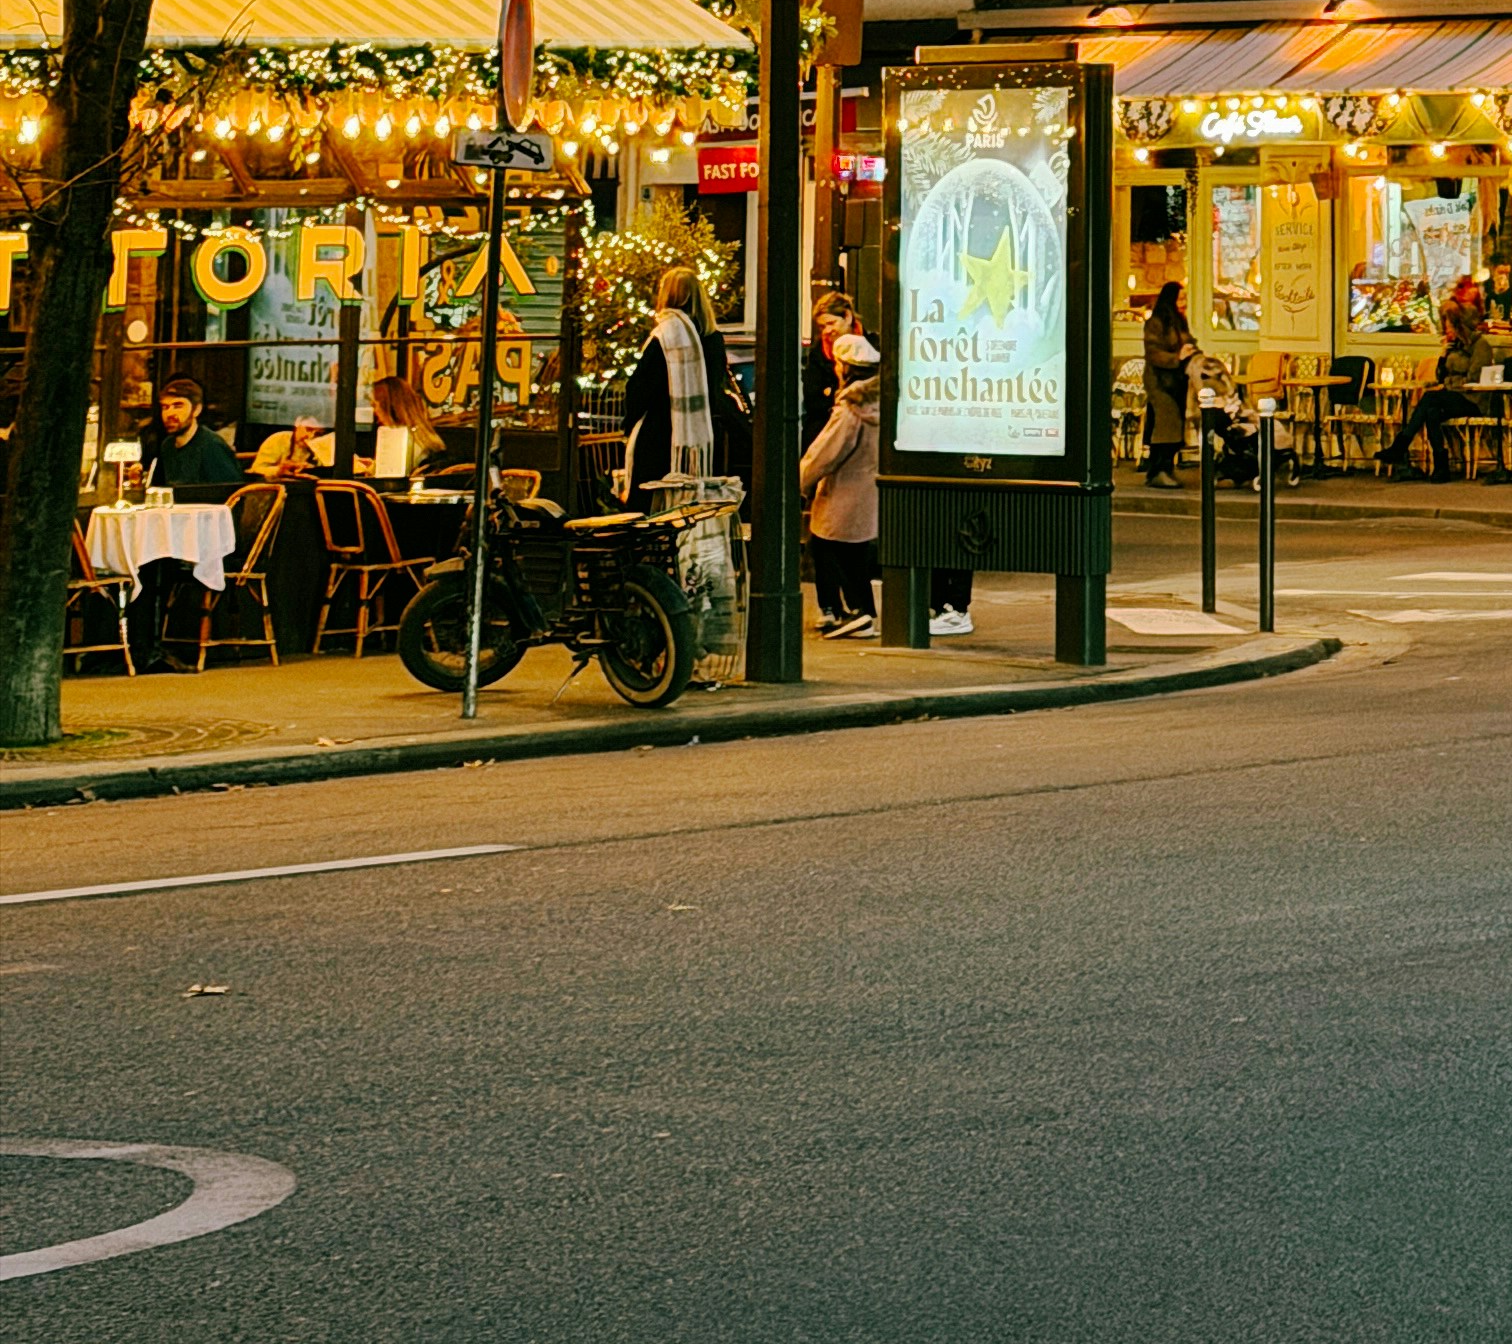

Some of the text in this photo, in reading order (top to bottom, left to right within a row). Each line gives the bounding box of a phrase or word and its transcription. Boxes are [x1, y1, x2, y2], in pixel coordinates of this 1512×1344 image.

[965, 133, 1005, 148] PARIS
[703, 162, 759, 180] FAST FO
[1274, 221, 1314, 236] SERVICE
[909, 288, 945, 323] La
[908, 326, 982, 362] forêt
[907, 366, 1059, 404] enchantée
